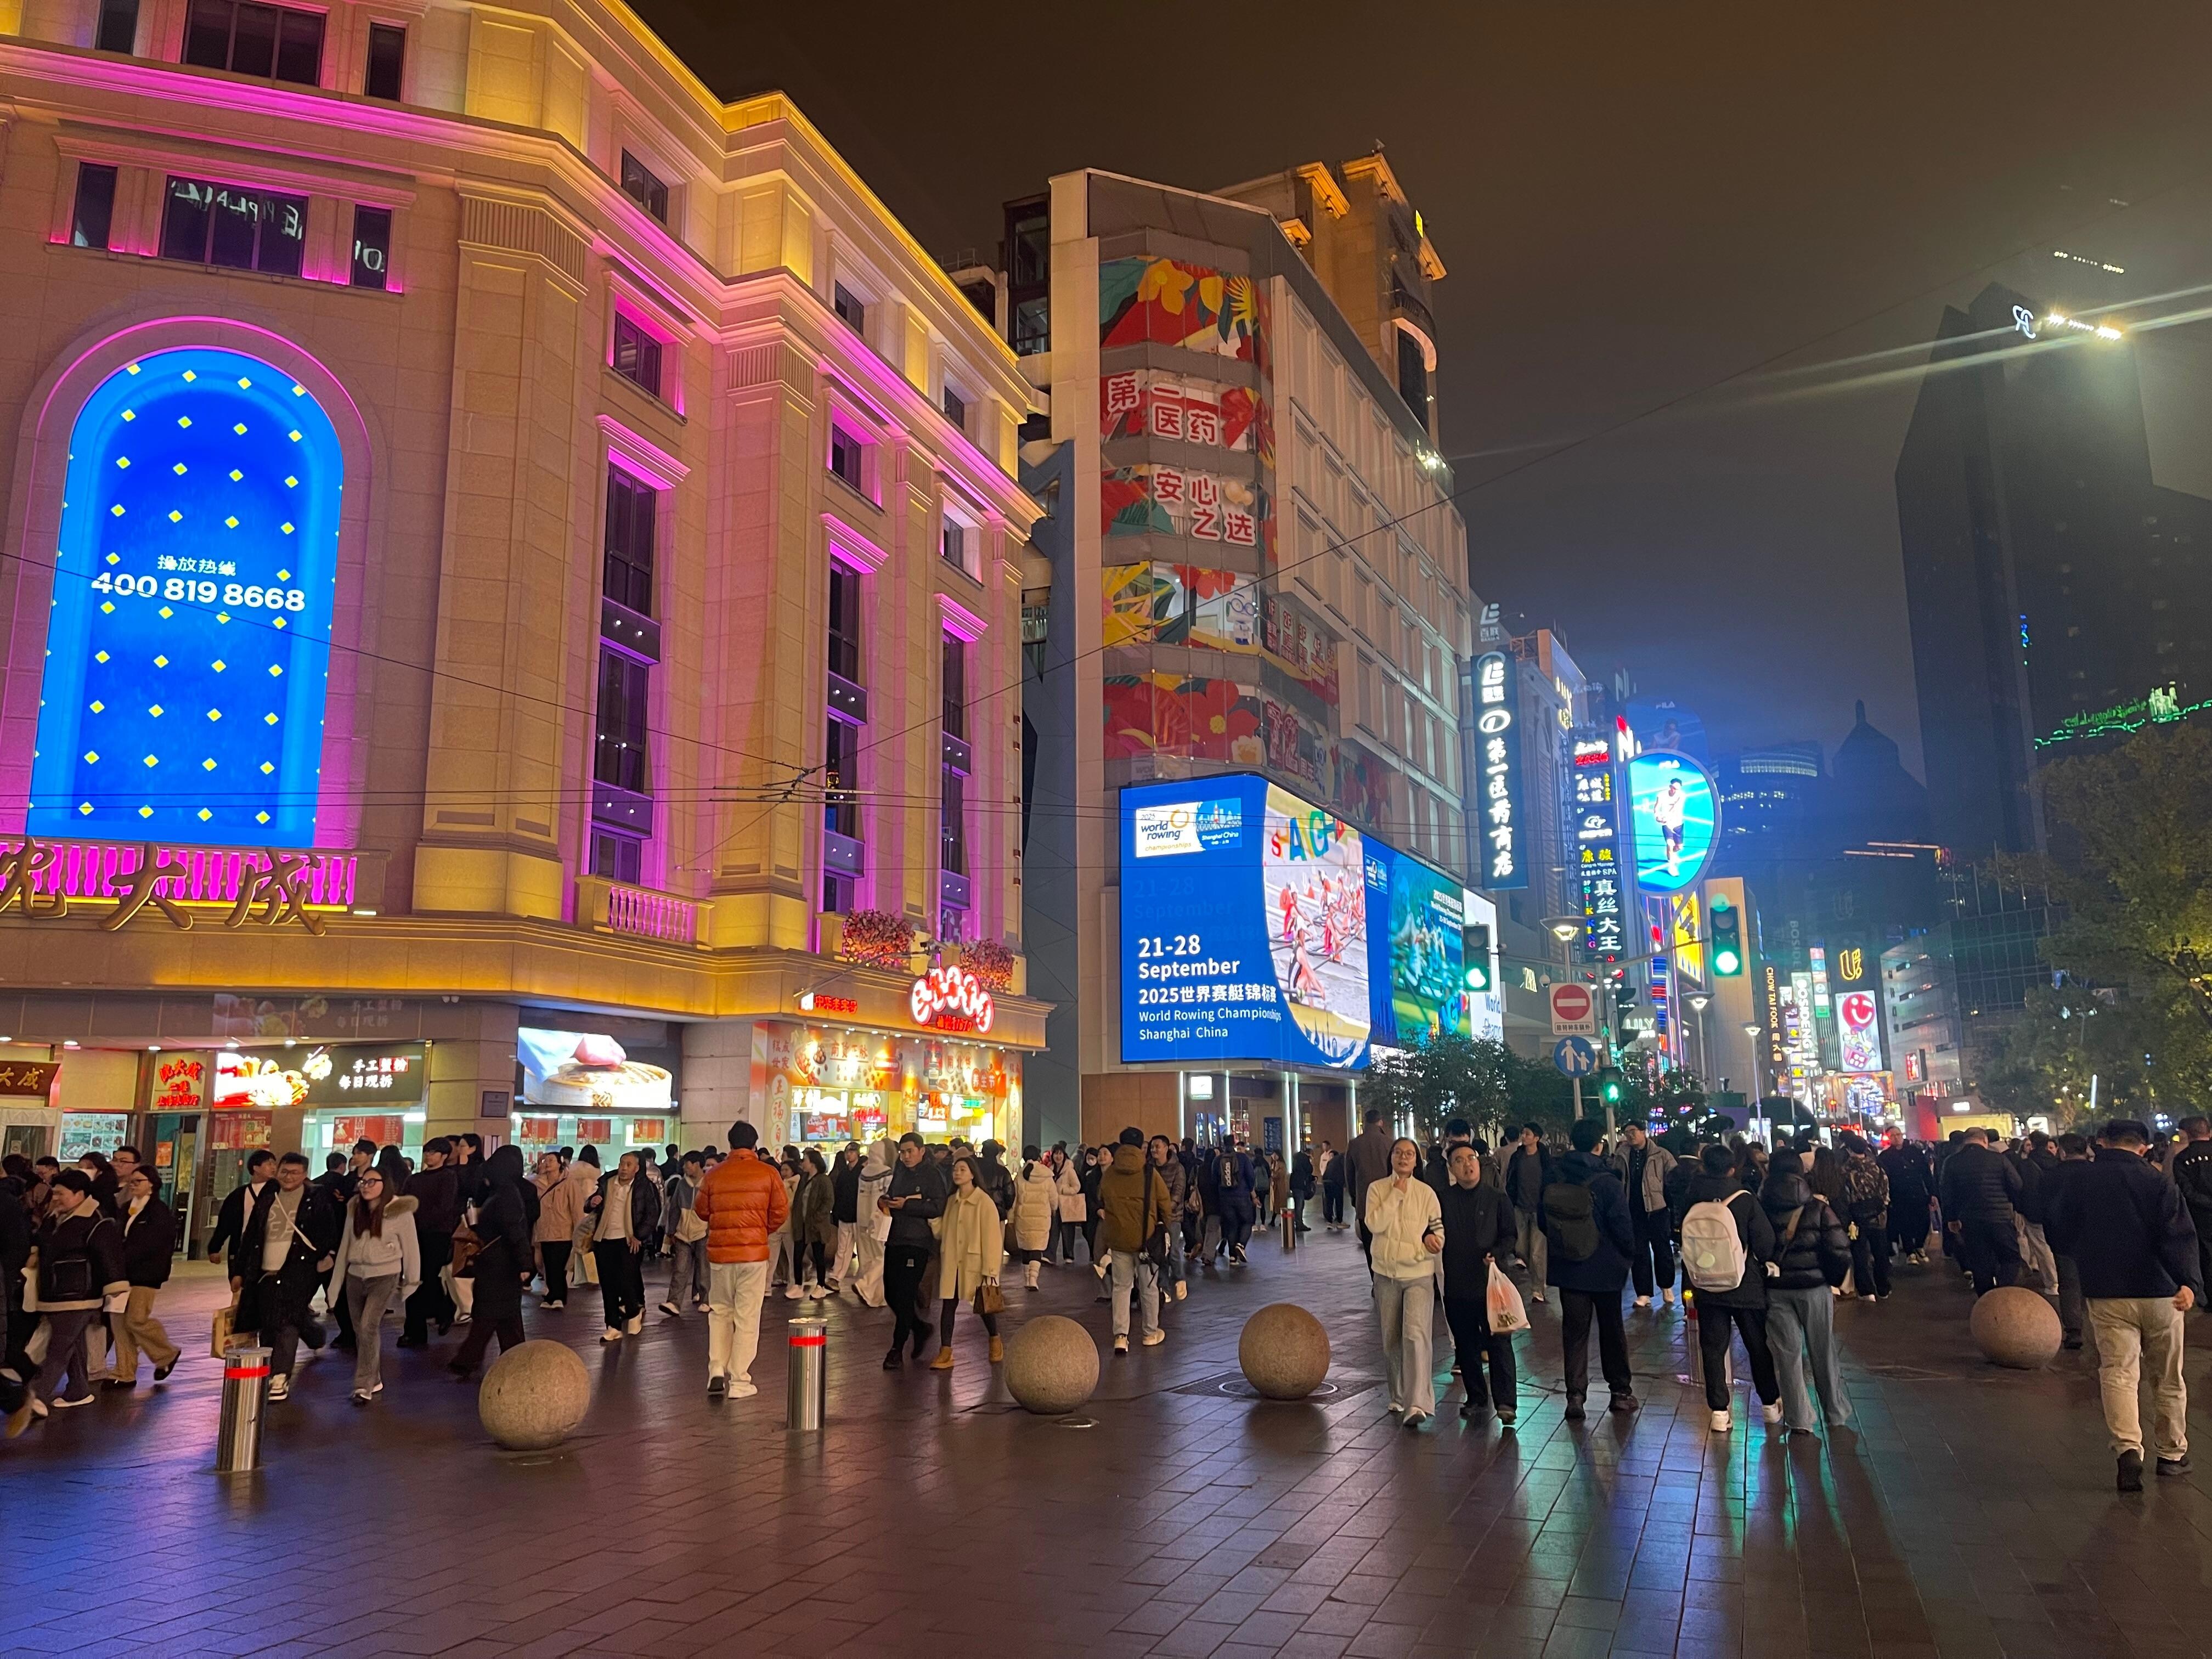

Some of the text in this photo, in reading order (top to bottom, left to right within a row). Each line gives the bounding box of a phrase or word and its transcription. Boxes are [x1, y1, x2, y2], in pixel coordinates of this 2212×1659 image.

[1107, 376, 1184, 413] 第一
[1152, 402, 1219, 445] 医药
[1153, 469, 1222, 508] 安心
[1191, 508, 1256, 546] 之选
[91, 572, 306, 612] 400 819 8668
[1486, 737, 1514, 878] 第一医药商店
[1141, 821, 1169, 833] world
[1147, 830, 1181, 840] rowing
[1145, 842, 1192, 851] championships
[1602, 867, 1617, 876] SPA
[1583, 886, 1594, 915] SILK
[1594, 879, 1622, 951] 真丝大王
[1138, 934, 1201, 958] 21-28
[1586, 919, 1596, 949] KING
[1138, 957, 1240, 981] September
[1766, 967, 1779, 1029] CHOW TAI FOOK
[1139, 1007, 1282, 1023] World Rowing Championships
[1626, 1017, 1655, 1030] LILY
[1139, 1026, 1228, 1042] Shanghai China
[339, 1074, 393, 1090] 每日现拆
[973, 1073, 996, 1089] 养生节
